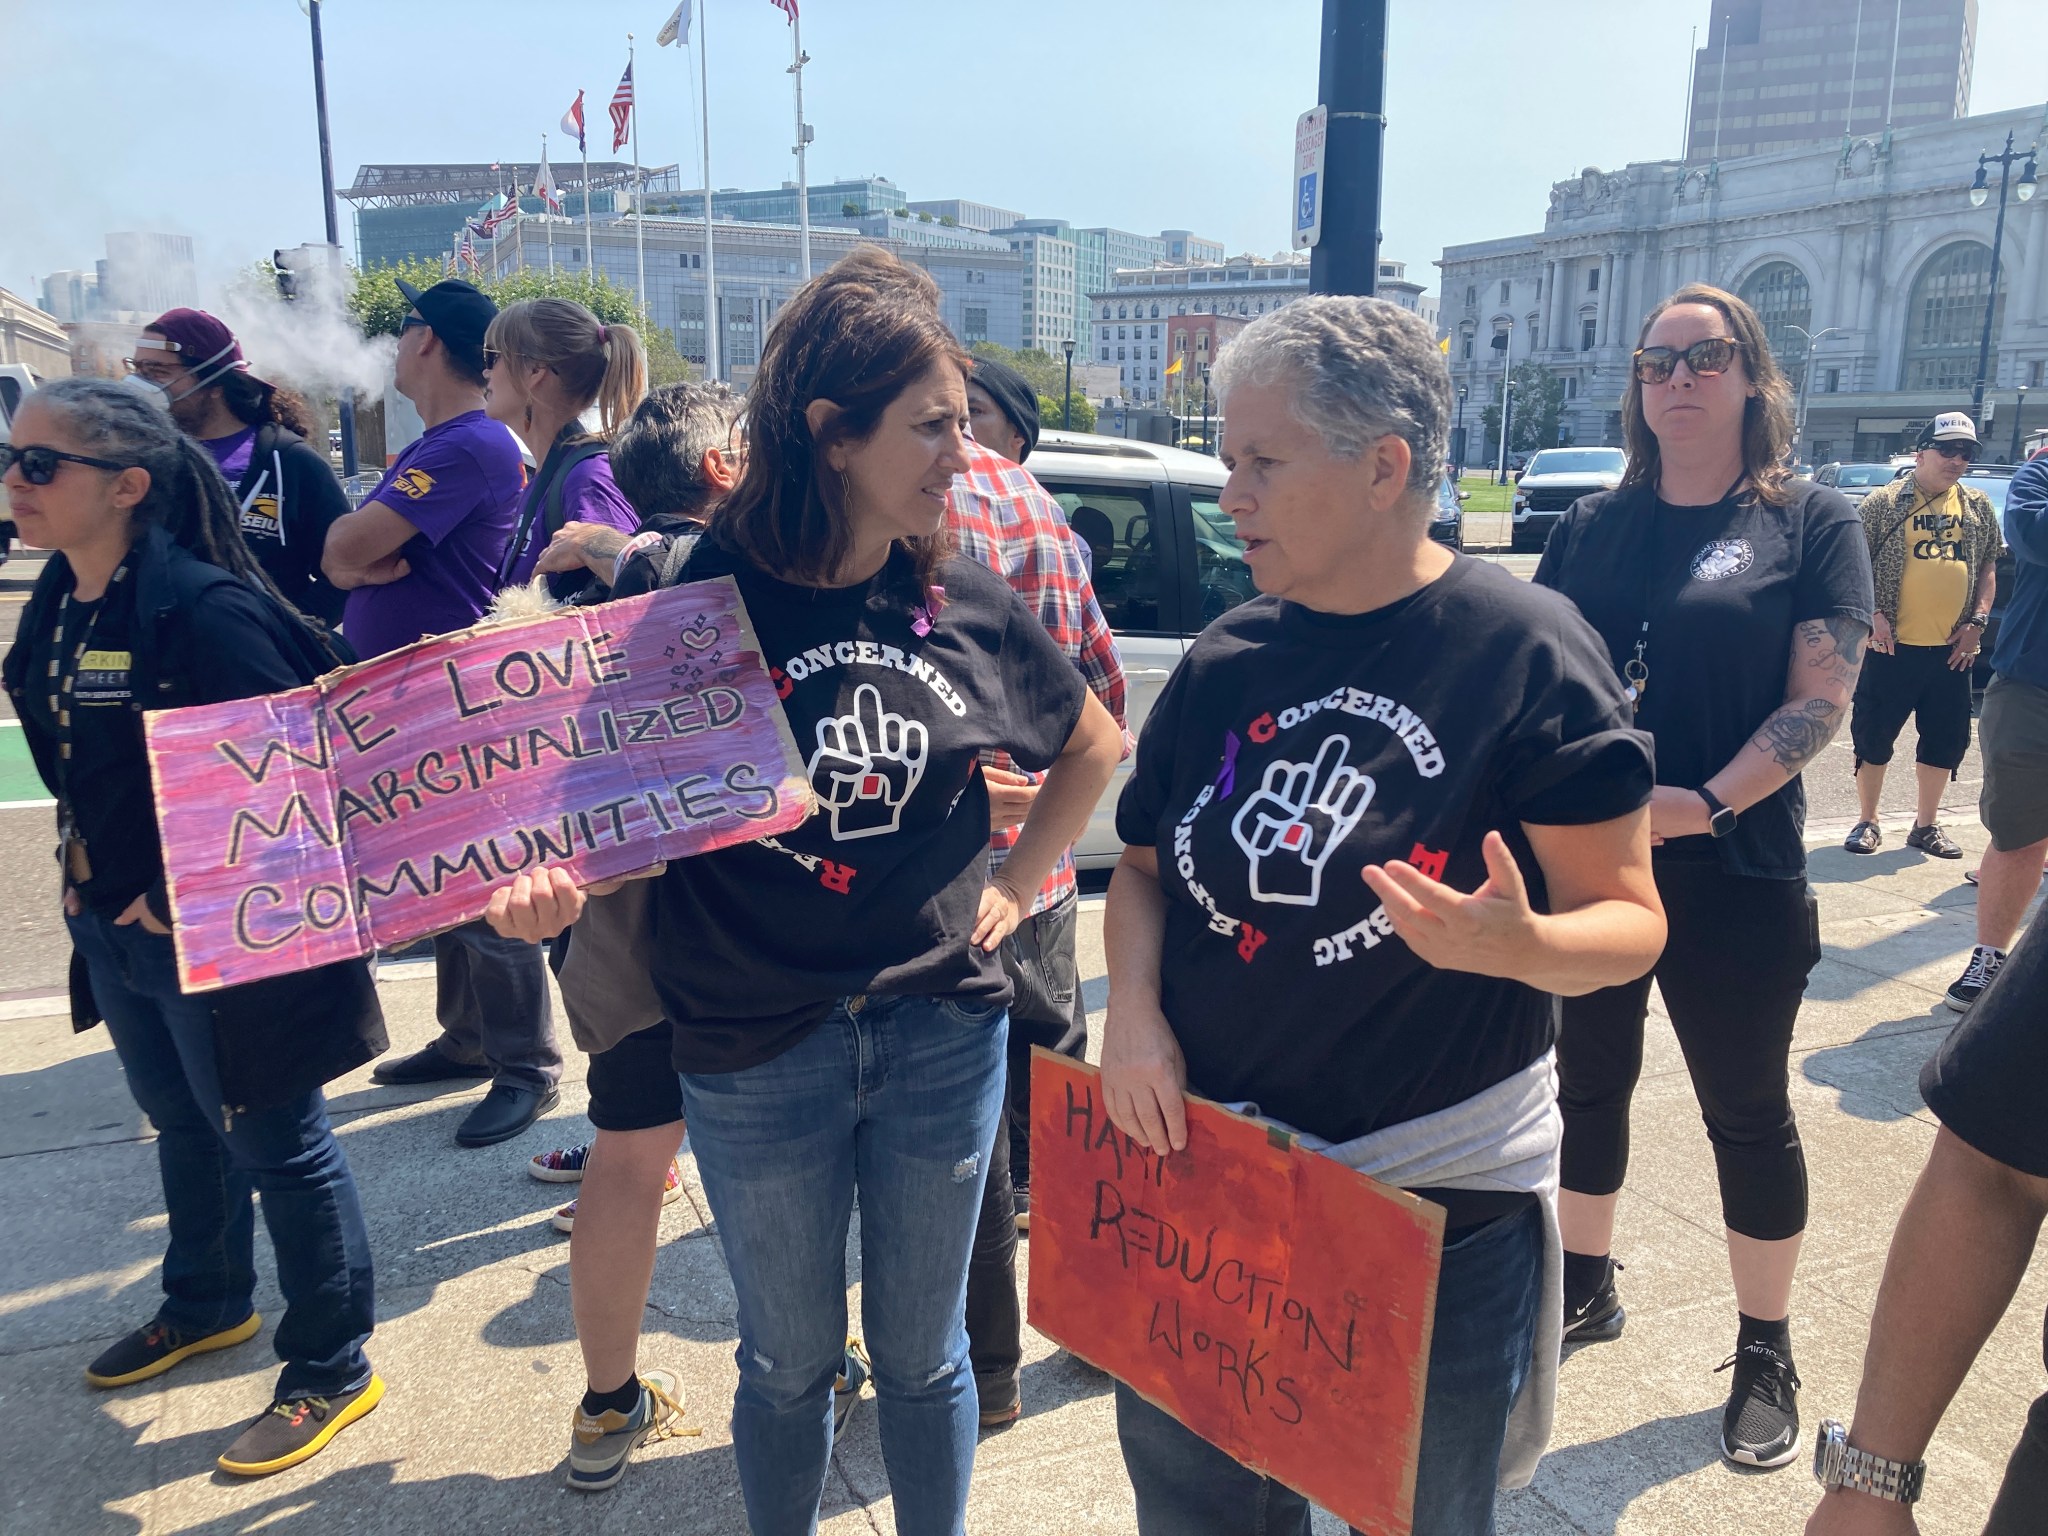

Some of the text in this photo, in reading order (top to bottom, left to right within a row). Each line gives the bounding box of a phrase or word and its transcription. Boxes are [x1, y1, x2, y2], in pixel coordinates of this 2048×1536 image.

[1296, 130, 1325, 155] PASSENGER
[1303, 151, 1316, 170] ZONE
[240, 515, 279, 531] SEIU
[1693, 566, 1740, 580] PROGRAM
[217, 632, 629, 784] WE LOVE
[1247, 686, 1446, 779] CONCERNED
[226, 687, 744, 868] MARGINALIZED
[234, 762, 779, 952] COMMUNITIES
[1312, 842, 1449, 967] PBLIC
